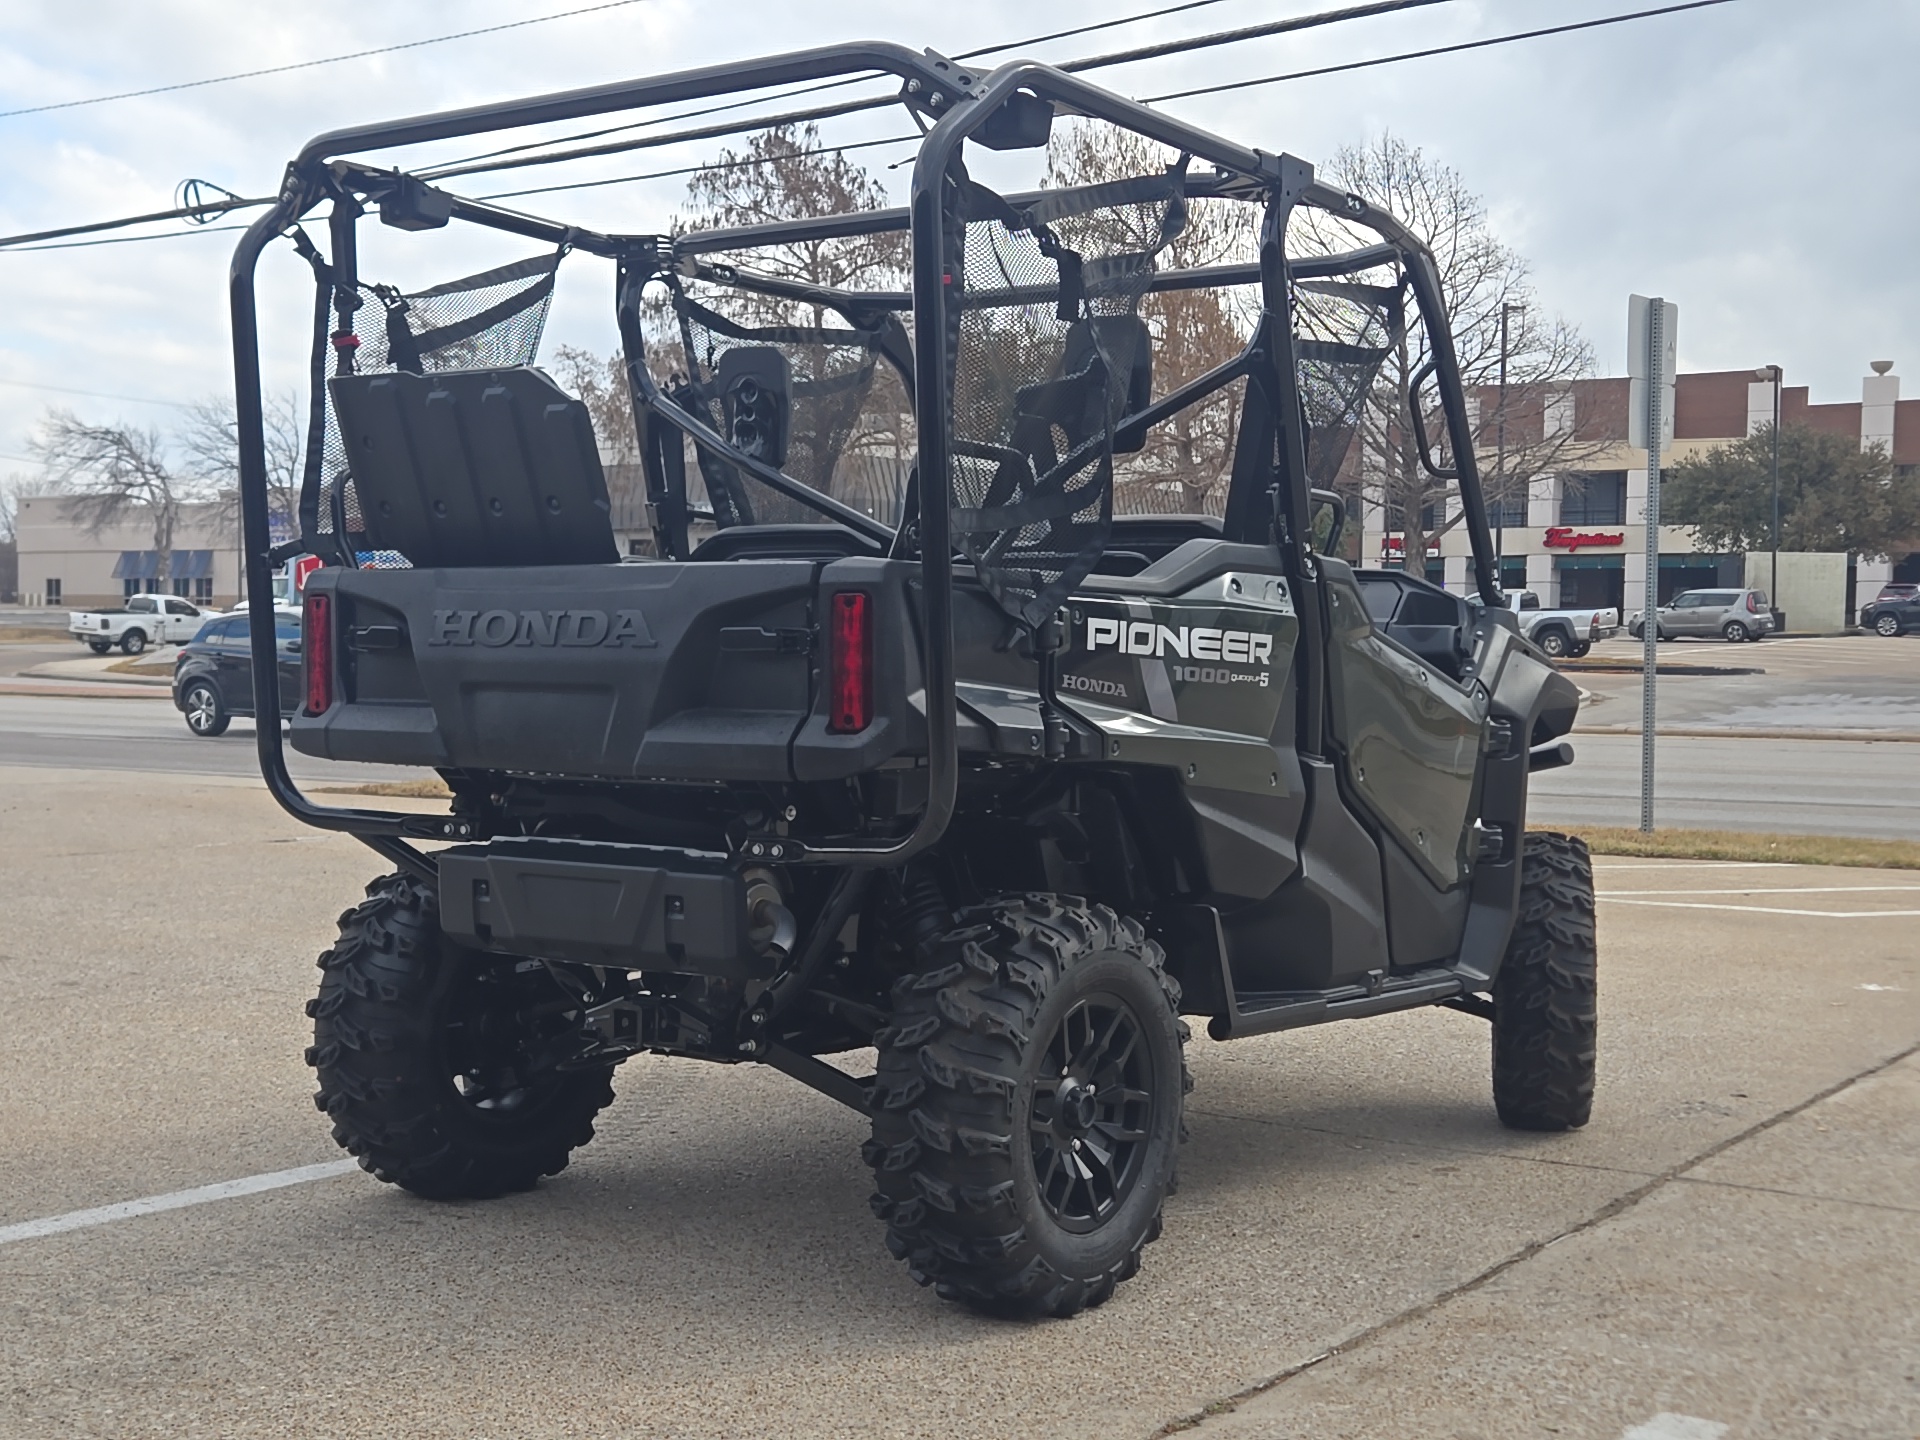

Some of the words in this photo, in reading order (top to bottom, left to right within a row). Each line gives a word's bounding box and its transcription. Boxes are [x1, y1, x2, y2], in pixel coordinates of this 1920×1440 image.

[428, 609, 659, 649] HONDA
[1087, 617, 1273, 665] PIONEER
[1061, 674, 1128, 698] HONDA
[1172, 665, 1231, 684] 1000
